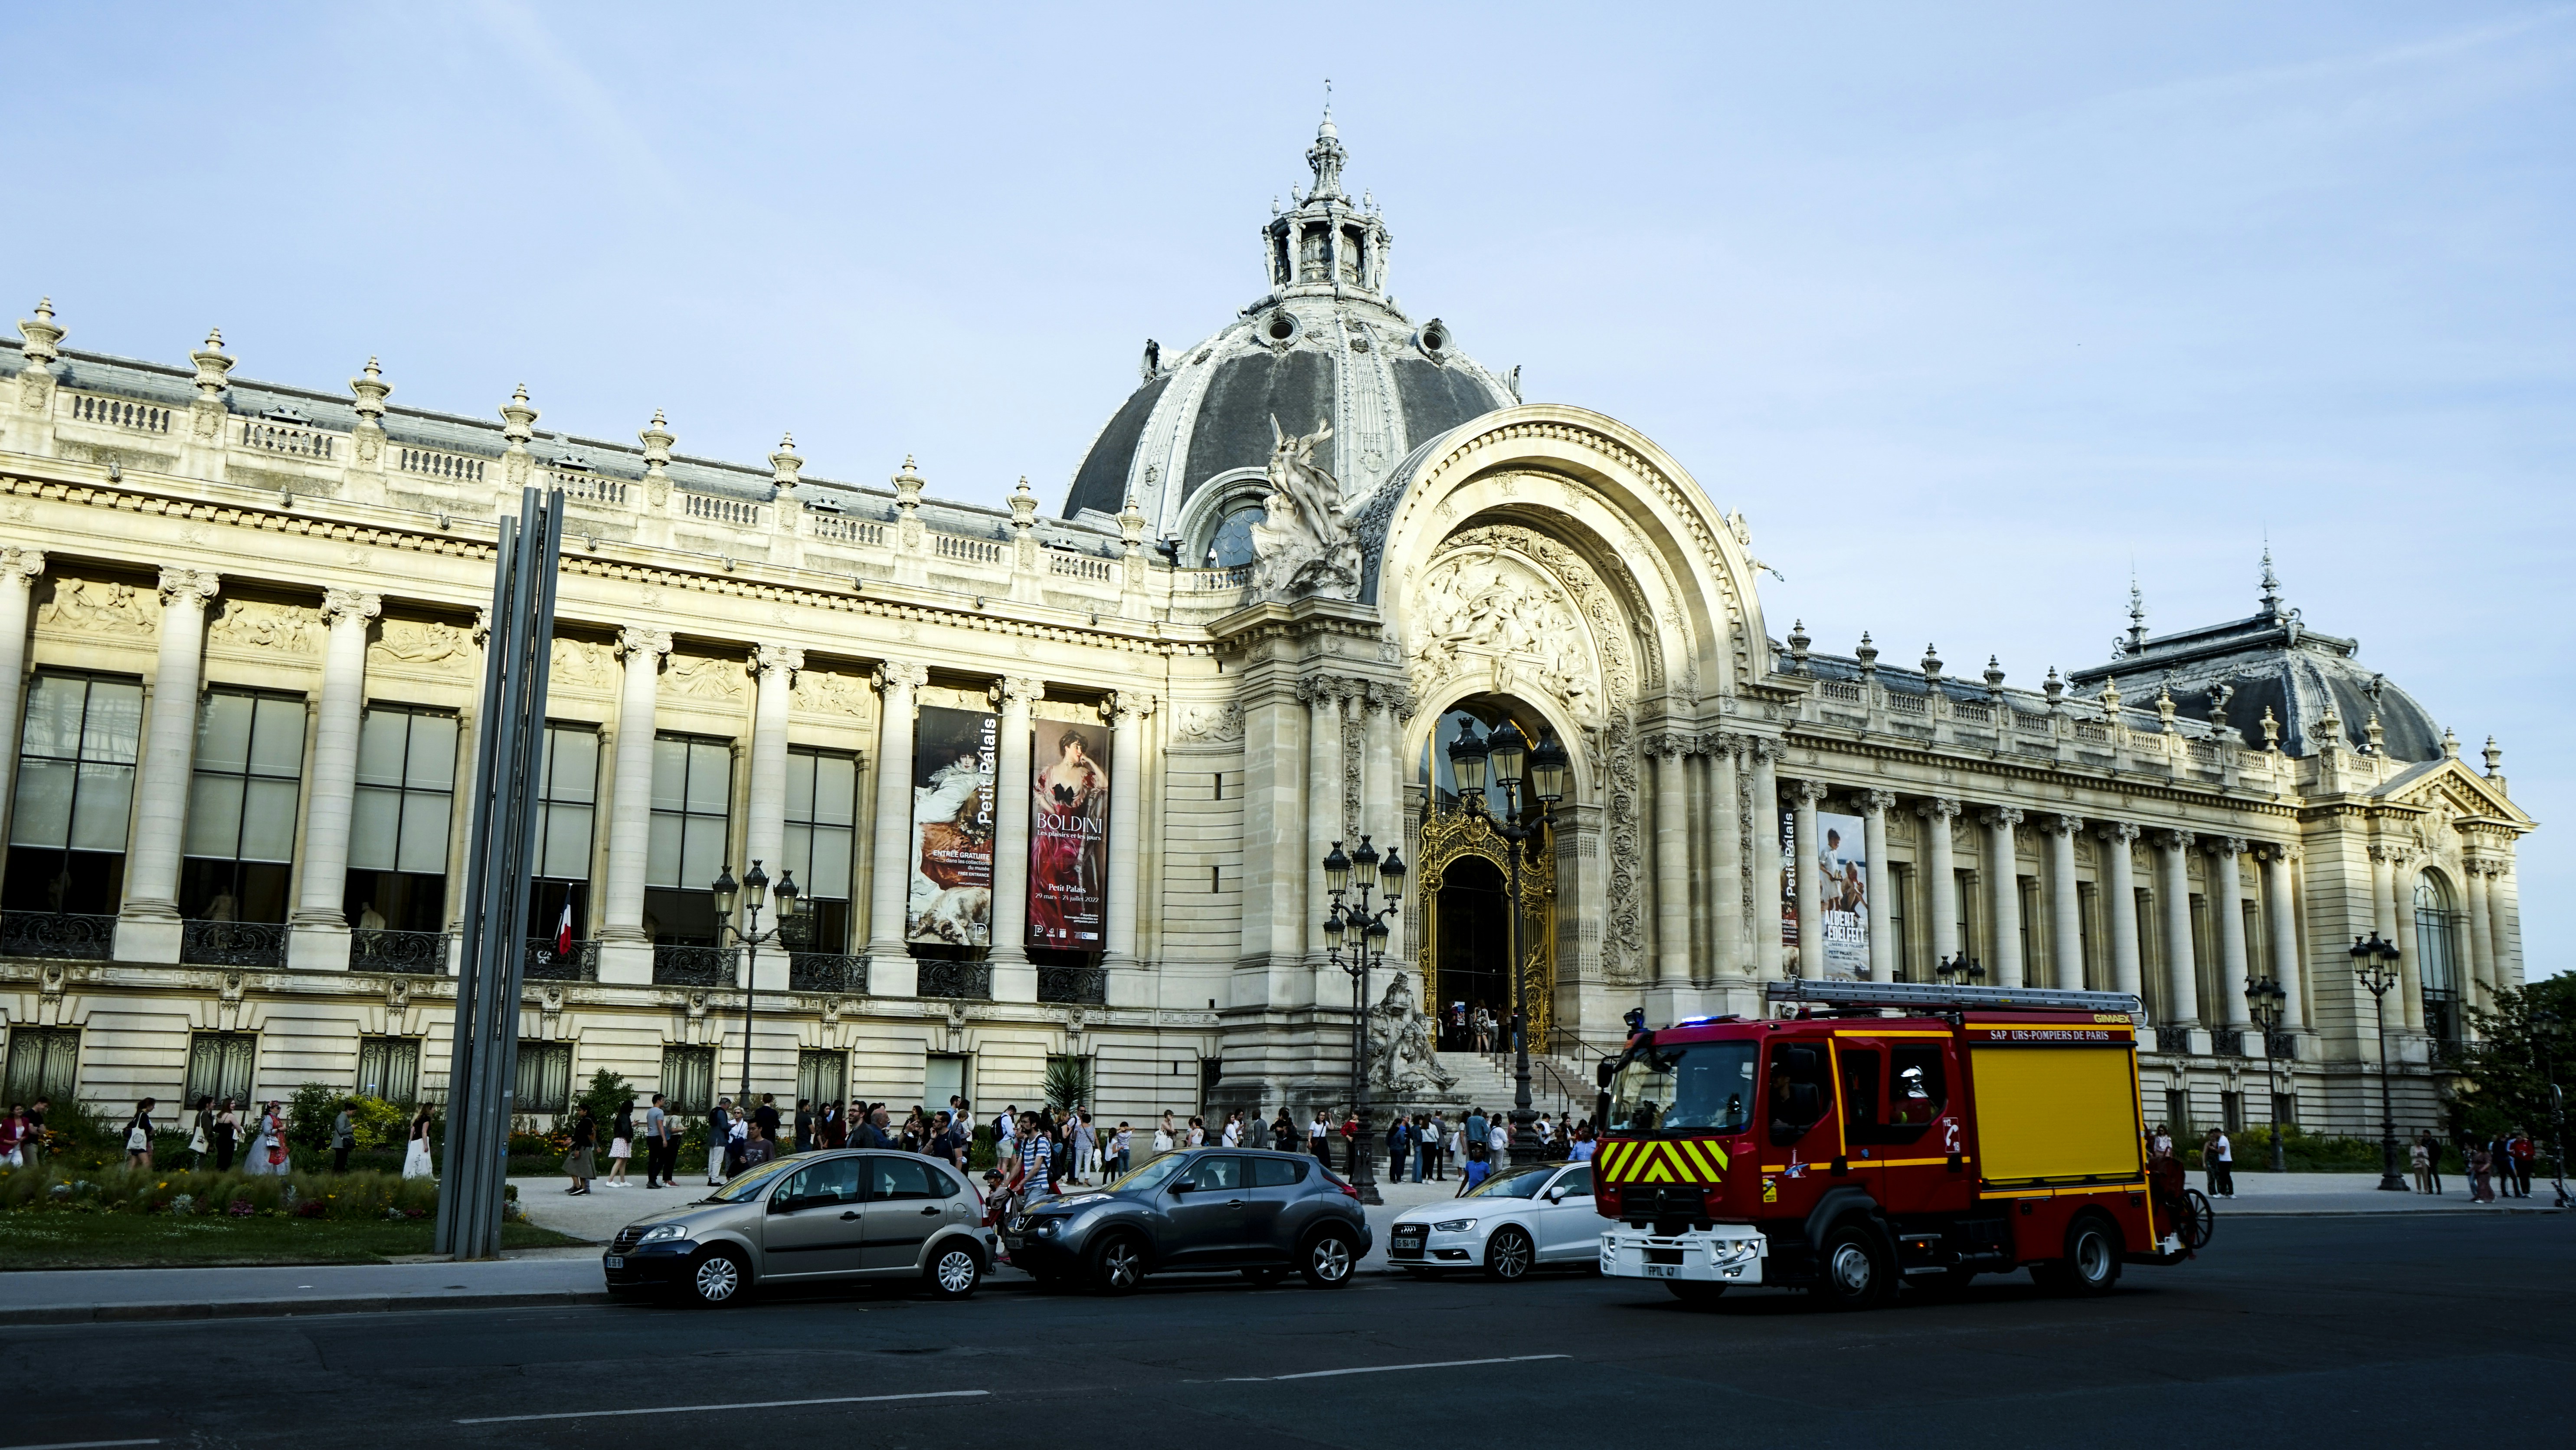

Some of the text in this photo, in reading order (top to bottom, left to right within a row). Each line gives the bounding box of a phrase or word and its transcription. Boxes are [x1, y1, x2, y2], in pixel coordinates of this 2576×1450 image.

[978, 718, 996, 824] Petit Palais
[1037, 813, 1102, 833] BOLDINI
[1784, 813, 1796, 897] Petit Palais
[1049, 883, 1086, 893] Petit Palais
[1825, 910, 1855, 927] ALBERT
[1828, 925, 1865, 943] EDELFELT
[2094, 1014, 2131, 1023] GIMAEX
[2073, 1031, 2085, 1040] DE
[2086, 1031, 2108, 1040] PARIS
[1953, 1142, 1960, 1151] 18
[1649, 1266, 1674, 1276] FPTL 47
